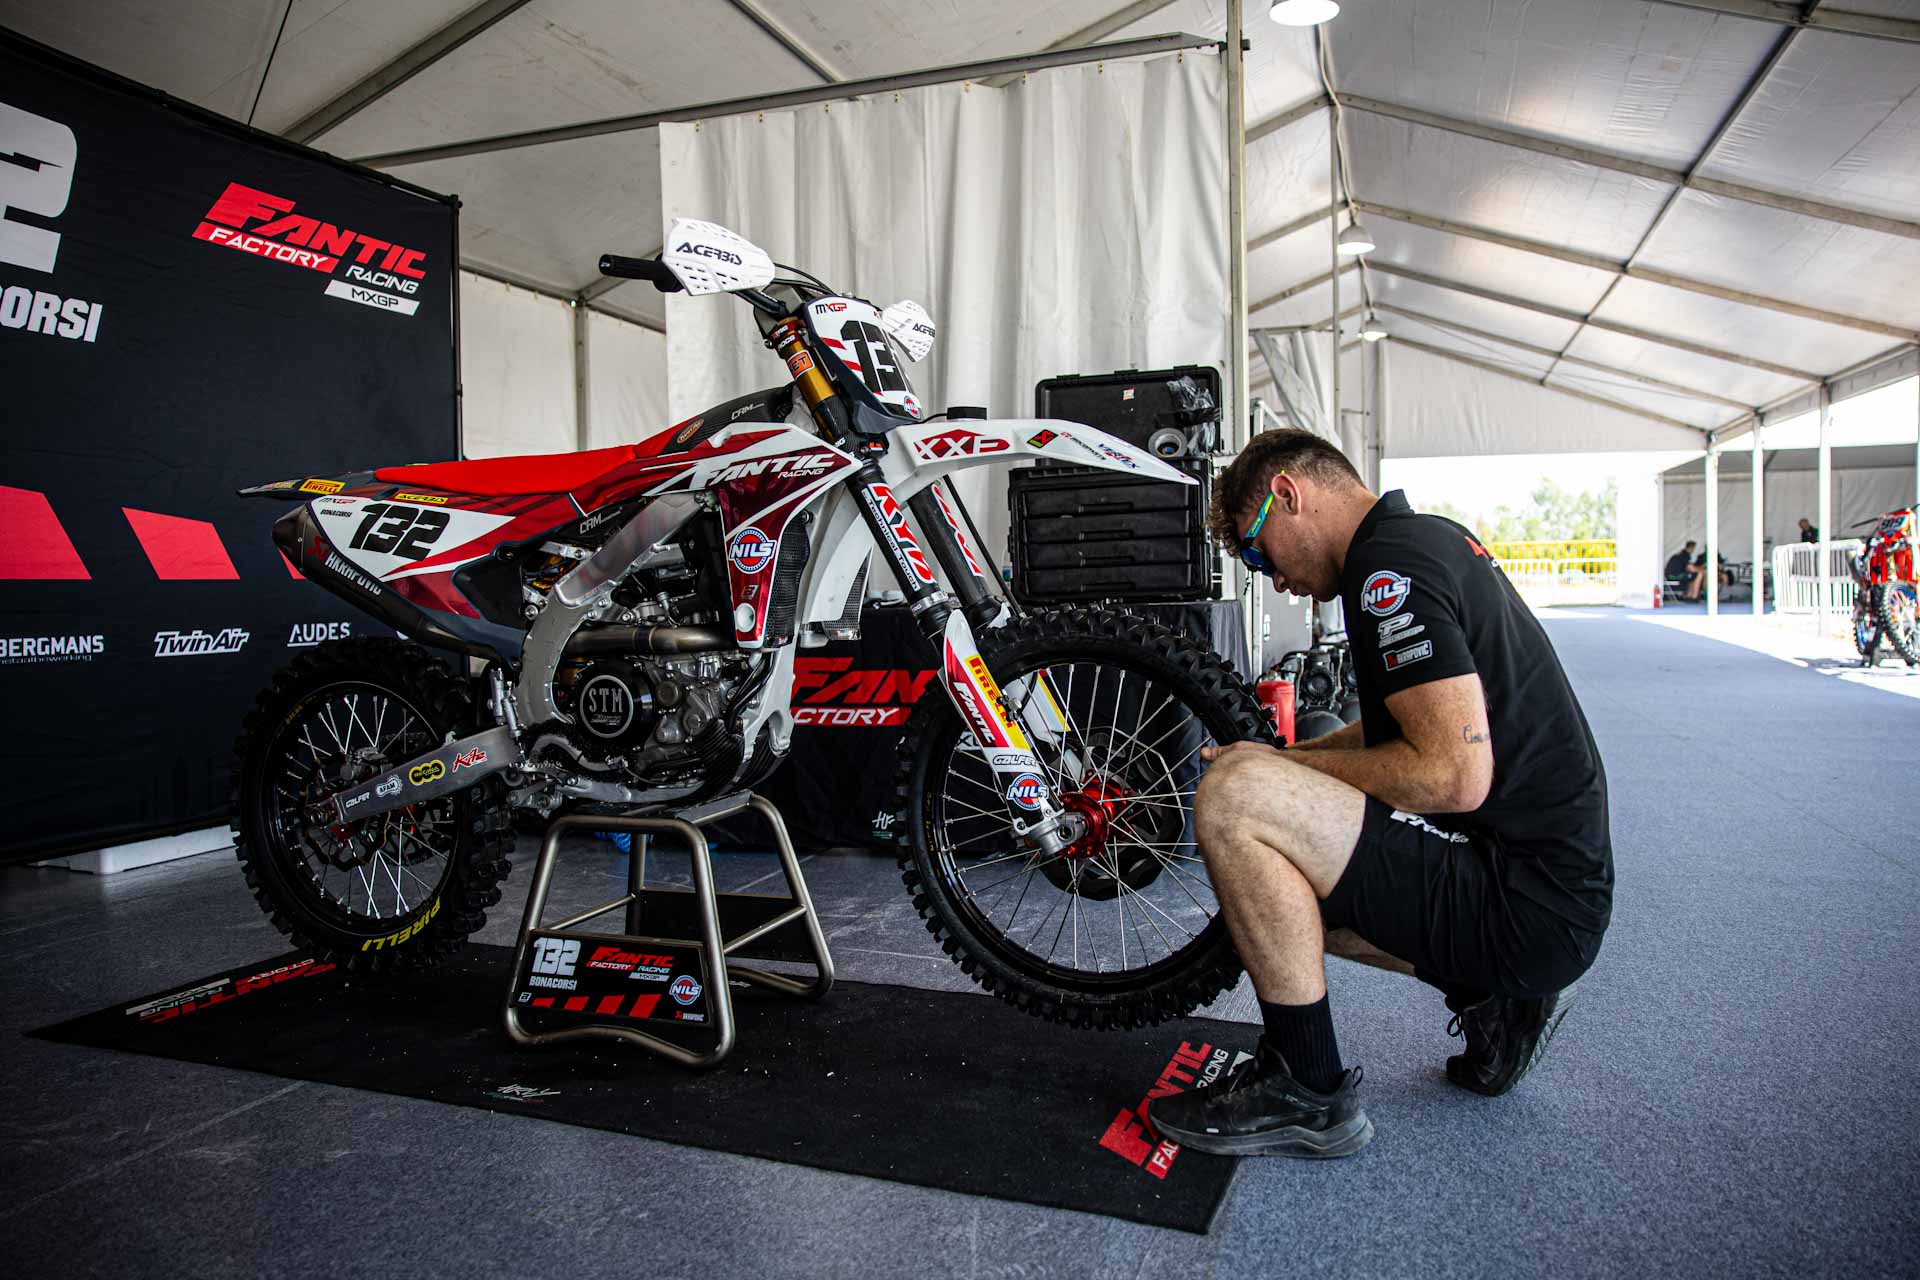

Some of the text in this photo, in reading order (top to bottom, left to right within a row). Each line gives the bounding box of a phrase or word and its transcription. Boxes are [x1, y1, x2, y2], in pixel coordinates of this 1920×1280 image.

[204, 181, 427, 280] FANTIC
[208, 227, 329, 269] FACTORY
[676, 241, 743, 266] ACERBIS
[345, 264, 419, 294] RACING
[351, 287, 399, 309] MXGP
[815, 302, 848, 315] MXGP
[0, 285, 103, 343] ORSI
[911, 322, 936, 339] ACERB
[840, 319, 917, 398] 13
[688, 453, 835, 490] FANTIC
[777, 467, 825, 479] RACING
[303, 480, 341, 494] PIRELLI
[399, 493, 444, 503] ACERBIS
[349, 503, 451, 562] 132
[868, 483, 938, 584] KYB
[729, 542, 776, 559] NILS
[1363, 579, 1408, 609] NILS
[290, 622, 350, 644] AUDES
[0, 634, 105, 657] BERGMANS
[792, 656, 938, 704] FAN
[588, 688, 623, 713] STM
[953, 681, 997, 743] FANTIC
[791, 707, 900, 725] CTORY
[379, 782, 398, 794] AFAM
[1011, 786, 1050, 800] NILS
[361, 895, 442, 952] PIRELLI
[532, 937, 582, 977] 132
[588, 946, 674, 968] FANTIC
[590, 961, 632, 970] FACTORY
[247, 958, 315, 983] CTORY
[637, 965, 671, 974] RACING
[529, 975, 577, 991] BONACORSI
[671, 984, 700, 995] NILS
